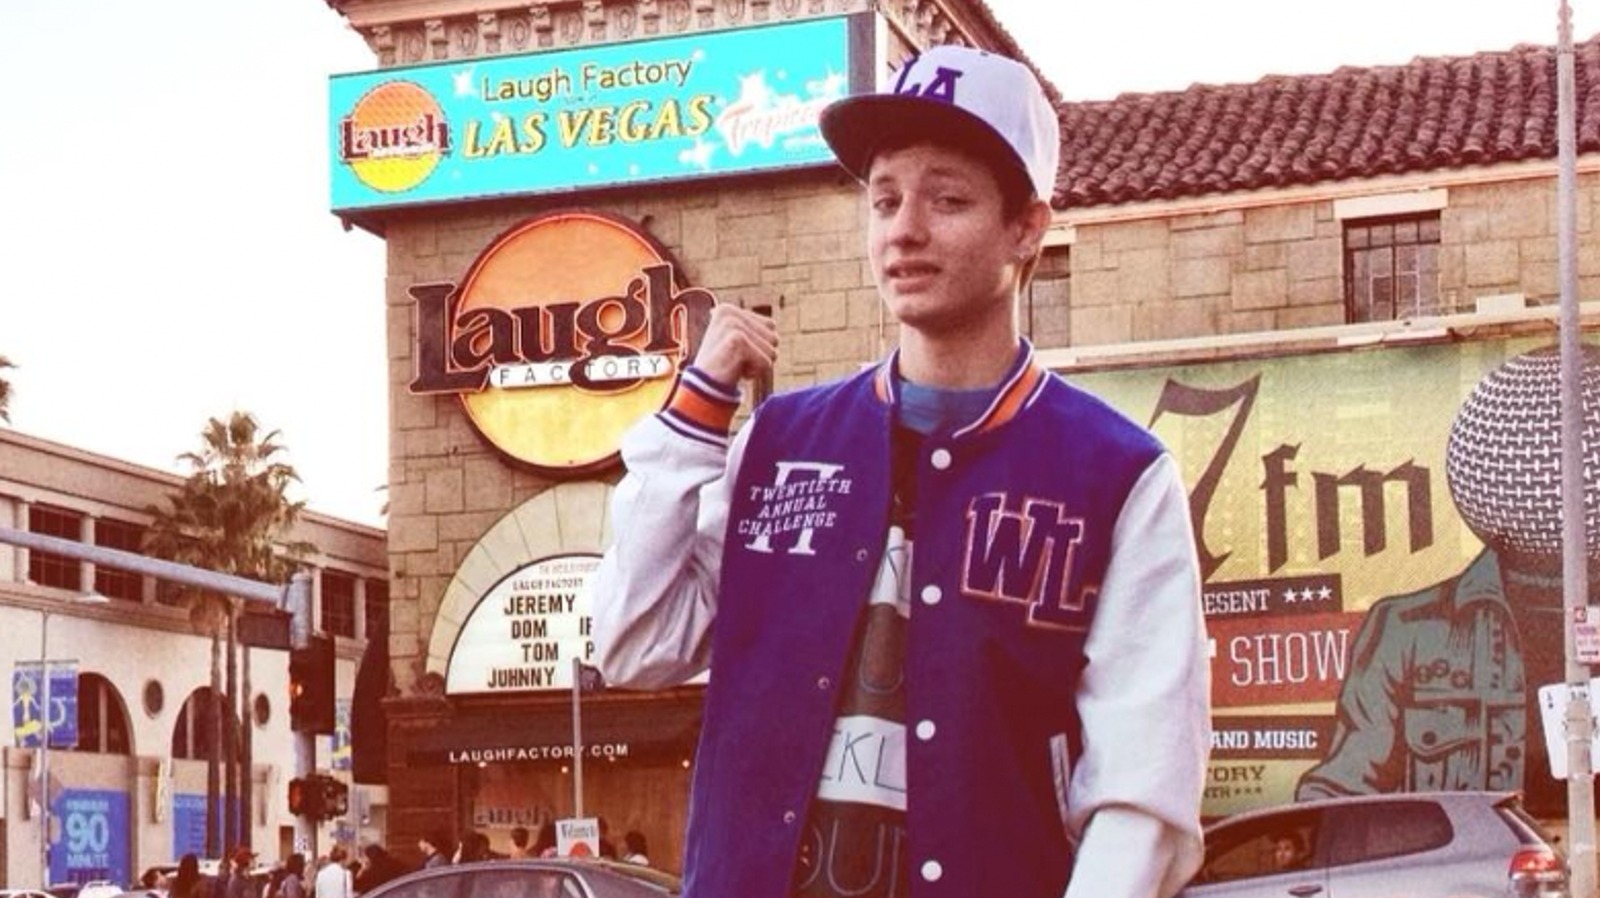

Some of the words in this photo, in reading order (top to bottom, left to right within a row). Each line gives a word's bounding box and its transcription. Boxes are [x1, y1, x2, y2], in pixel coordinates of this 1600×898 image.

[484, 67, 571, 103] Laugh
[583, 57, 694, 91] Factory
[340, 113, 452, 164] Laugh
[462, 110, 547, 158] LAS
[558, 95, 715, 149] VEGAS
[407, 261, 718, 394] Laugh
[499, 357, 663, 386] FACTORY
[750, 479, 852, 501] TWENTIETH
[758, 495, 826, 519] ANNUAL
[738, 511, 838, 536] CHALLENGE
[960, 492, 1100, 630] WL
[504, 594, 576, 615] JEREMY
[511, 618, 547, 640] DOM
[521, 643, 559, 662] TOM
[1230, 629, 1350, 687] SHOW
[487, 667, 555, 688] JOHNNY
[1211, 730, 1249, 749] AND
[1253, 730, 1318, 750] MUSIC
[1207, 764, 1265, 783] ORY
[65, 812, 110, 853] 90
